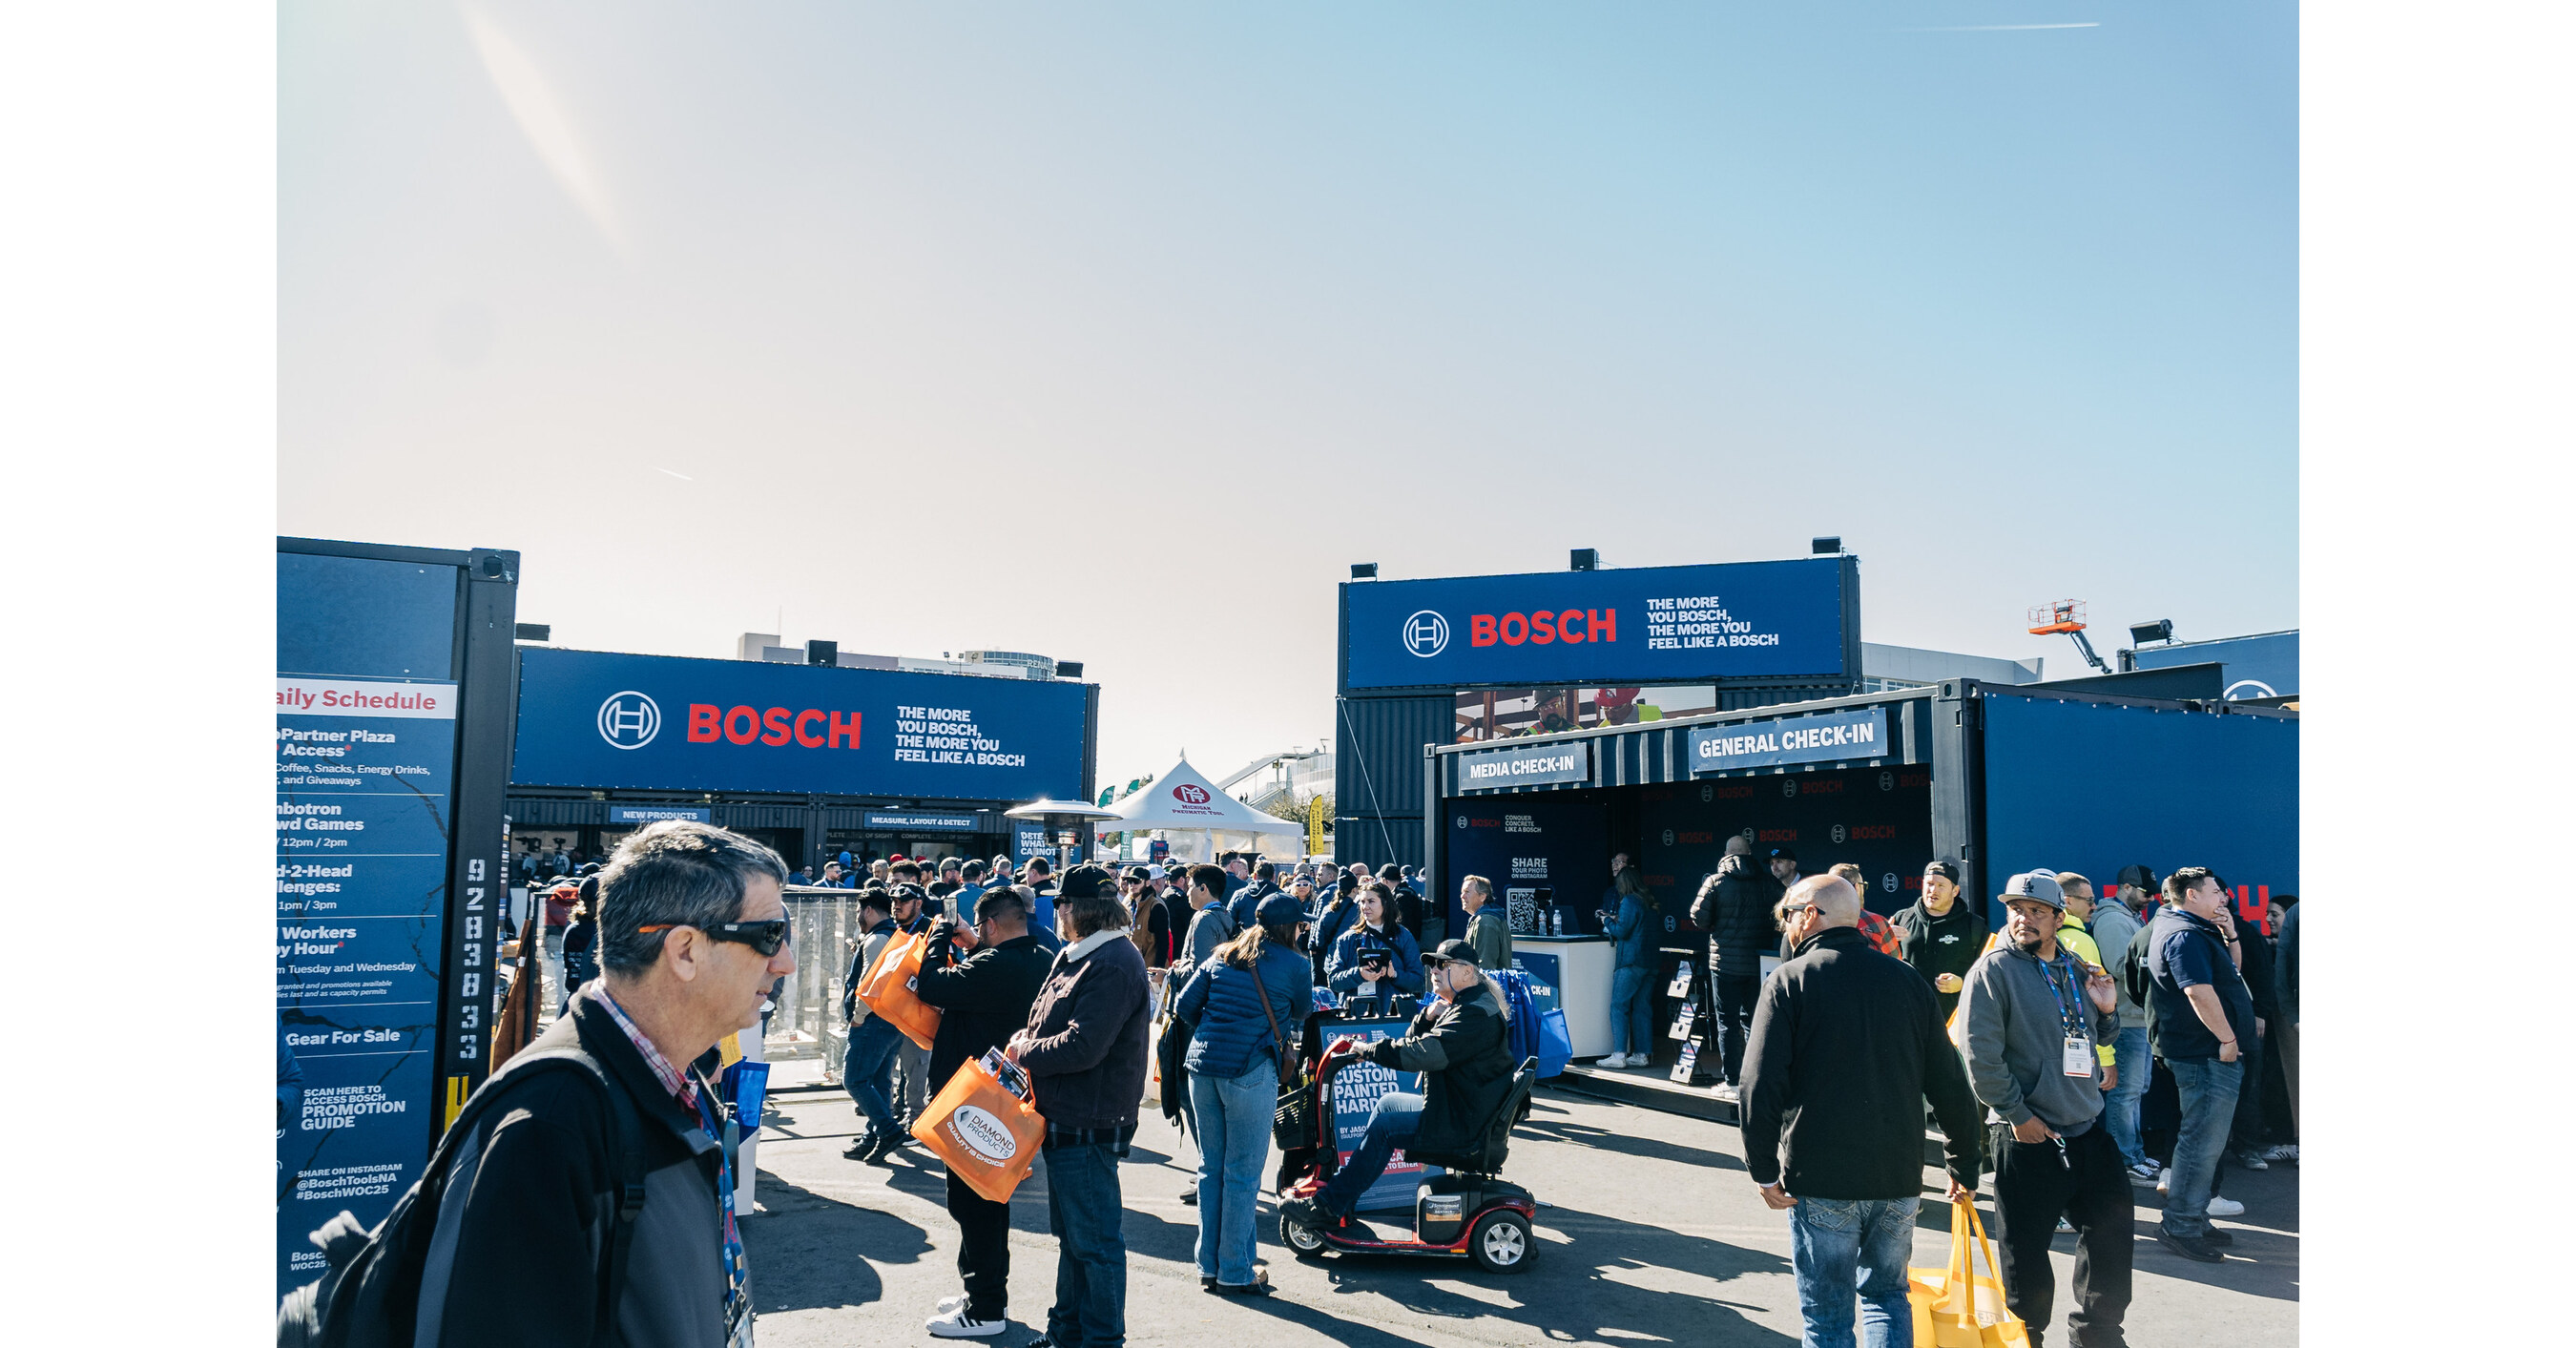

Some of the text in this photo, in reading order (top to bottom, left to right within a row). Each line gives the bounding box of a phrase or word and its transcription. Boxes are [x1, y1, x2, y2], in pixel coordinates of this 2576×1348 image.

[1647, 596, 1719, 611] THE MORE
[1647, 609, 1732, 623] YOU BOSCH,
[1470, 608, 1617, 647] BOSCH
[1648, 621, 1751, 636] THE MORE YOU
[1649, 633, 1779, 650] FEEL LIKE A BOSCH
[322, 690, 436, 710] Schedule
[897, 706, 971, 722] THE MORE
[687, 703, 862, 750] BOSCH
[896, 720, 982, 738] YOU BOSCH,
[350, 730, 396, 744] Plaza
[895, 735, 1000, 752] THE MORE YOU
[1698, 722, 1875, 758] GENERAL CHECK-IN
[894, 749, 1026, 767] FEEL LIKE A BOSCH
[314, 764, 355, 775] Snacks,
[358, 765, 393, 776] Energy
[395, 765, 430, 776] Drinks,
[1470, 756, 1574, 778] MEDIA CHECK-IN
[283, 776, 304, 784] and
[306, 776, 362, 786] Giveaways
[1802, 779, 1842, 794] BOSCH
[1718, 786, 1754, 798] BOSCH
[623, 811, 697, 820] NEW PRODUCTS
[872, 817, 909, 825] MEASURE,
[304, 818, 364, 831] Games
[1471, 819, 1501, 827] BOSCH
[1678, 832, 1713, 843] BOSCH
[1759, 829, 1797, 841] BOSCH
[1852, 825, 1896, 840] BOSCH
[282, 838, 313, 848] 12pm
[315, 838, 322, 848] /
[323, 838, 347, 848] 2pm
[1511, 858, 1548, 867] SHARE
[279, 900, 337, 911] 1pm / 3pm
[282, 927, 357, 940] Workers
[288, 964, 331, 975] Tuesday
[334, 963, 354, 972] and
[357, 962, 416, 973] Wednesday
[321, 981, 361, 989] promotions
[360, 988, 387, 997] permits
[286, 1029, 401, 1046] Gear For Sale
[1335, 1068, 1397, 1085] CUSTOM
[303, 1085, 382, 1097] SCAN HERE TO
[1334, 1082, 1400, 1099] PAINTED
[302, 1093, 386, 1106] ACCESS BOSCH
[301, 1101, 405, 1118] PROMOTION
[301, 1116, 356, 1130] GUIDE
[966, 1123, 1010, 1157] PRODUCTS
[971, 1115, 1015, 1151] DIAMOND
[946, 1121, 970, 1151] QUALITY
[975, 1152, 1006, 1168] CHOICE
[298, 1164, 403, 1178] SHARE ON INSTAGRAM
[297, 1173, 397, 1191] @BoschToolsNA
[296, 1185, 389, 1200] #BoschWOC25
[290, 1260, 326, 1271] WOC25
